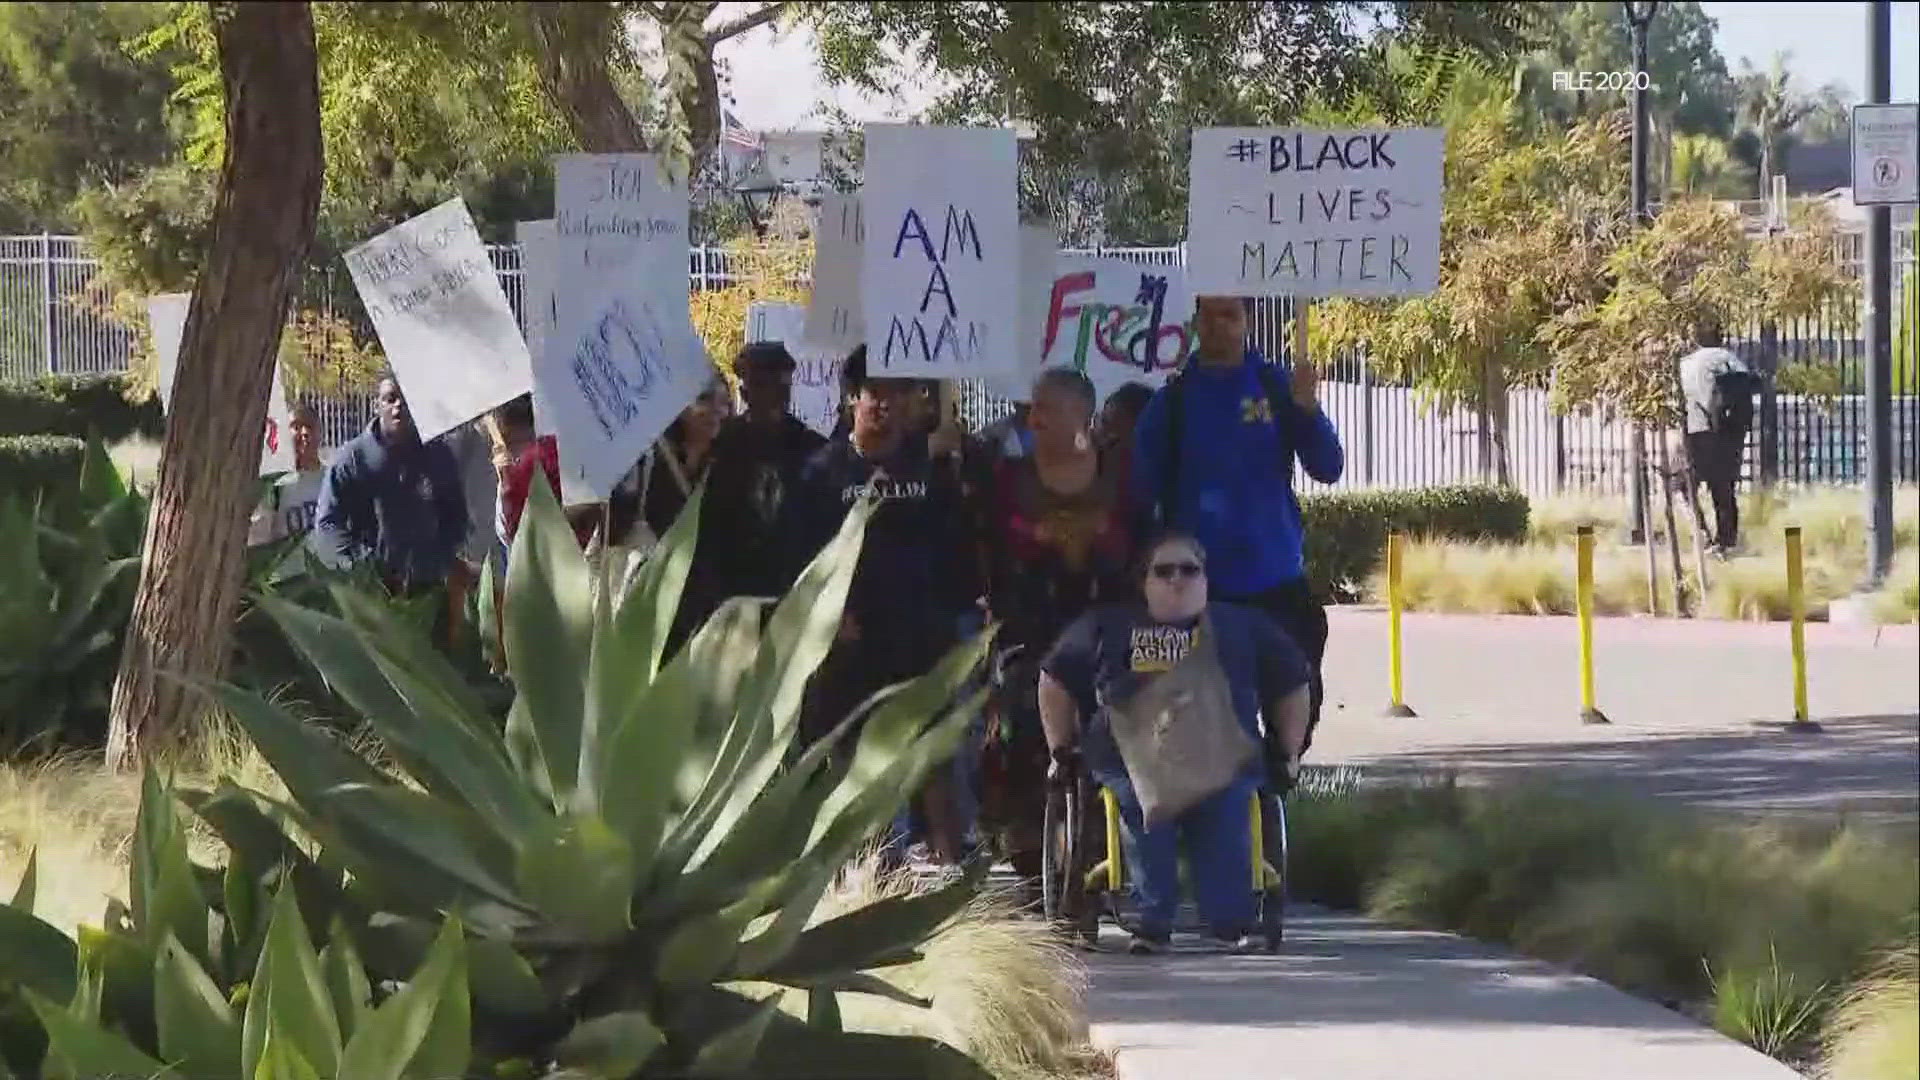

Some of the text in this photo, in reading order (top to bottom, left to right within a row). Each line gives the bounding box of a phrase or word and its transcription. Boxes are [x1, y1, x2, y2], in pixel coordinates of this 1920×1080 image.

[893, 205, 982, 262] AM
[1240, 234, 1412, 282] MATTER
[920, 262, 957, 318] A
[885, 314, 988, 369] MAN
[1040, 271, 1196, 376] Freedo
